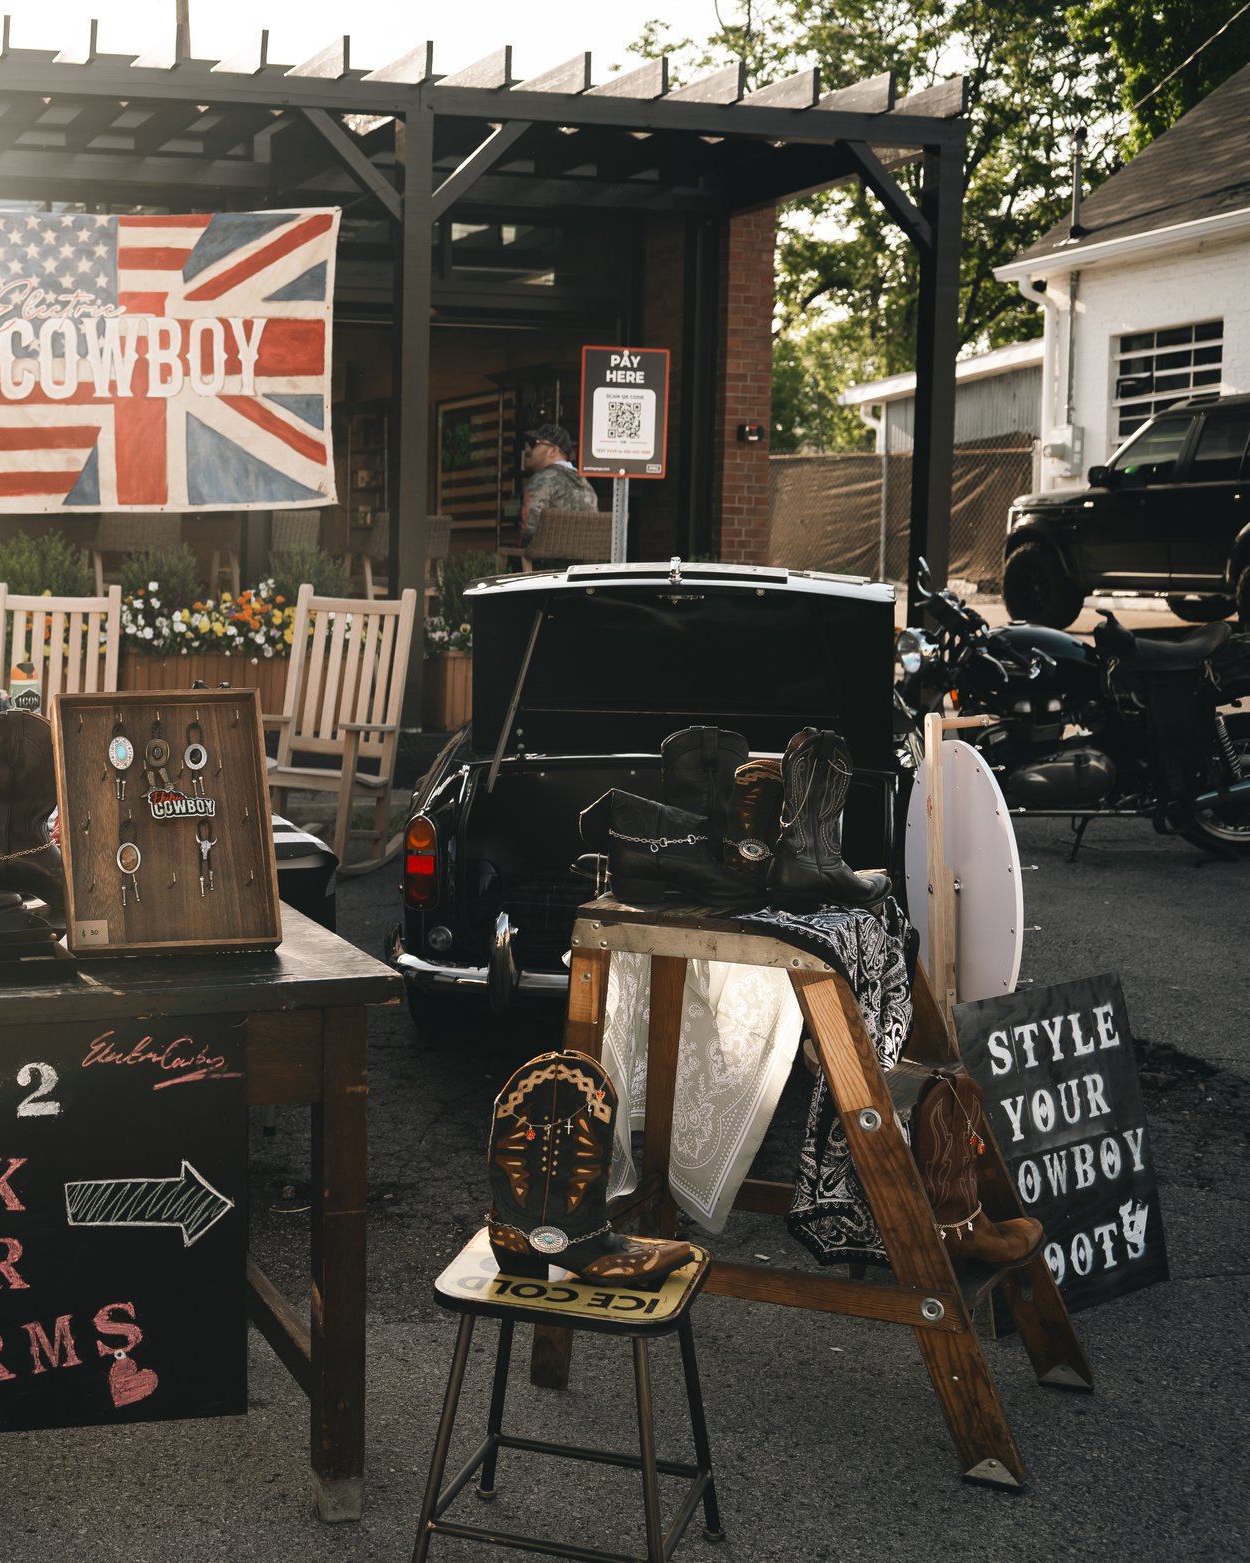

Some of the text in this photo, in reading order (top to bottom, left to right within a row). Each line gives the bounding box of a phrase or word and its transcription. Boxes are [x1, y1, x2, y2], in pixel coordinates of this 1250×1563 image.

[606, 369, 645, 384] HERE
[610, 354, 641, 368] PAY
[19, 696, 39, 706] ICON
[154, 799, 213, 816] COWBOY
[987, 1003, 1121, 1076] STYLE
[1000, 1073, 1111, 1142] YOUR
[1017, 1128, 1145, 1204] OWBOY
[1043, 1205, 1150, 1286] OOTS
[456, 1275, 661, 1314] ICE COLD
